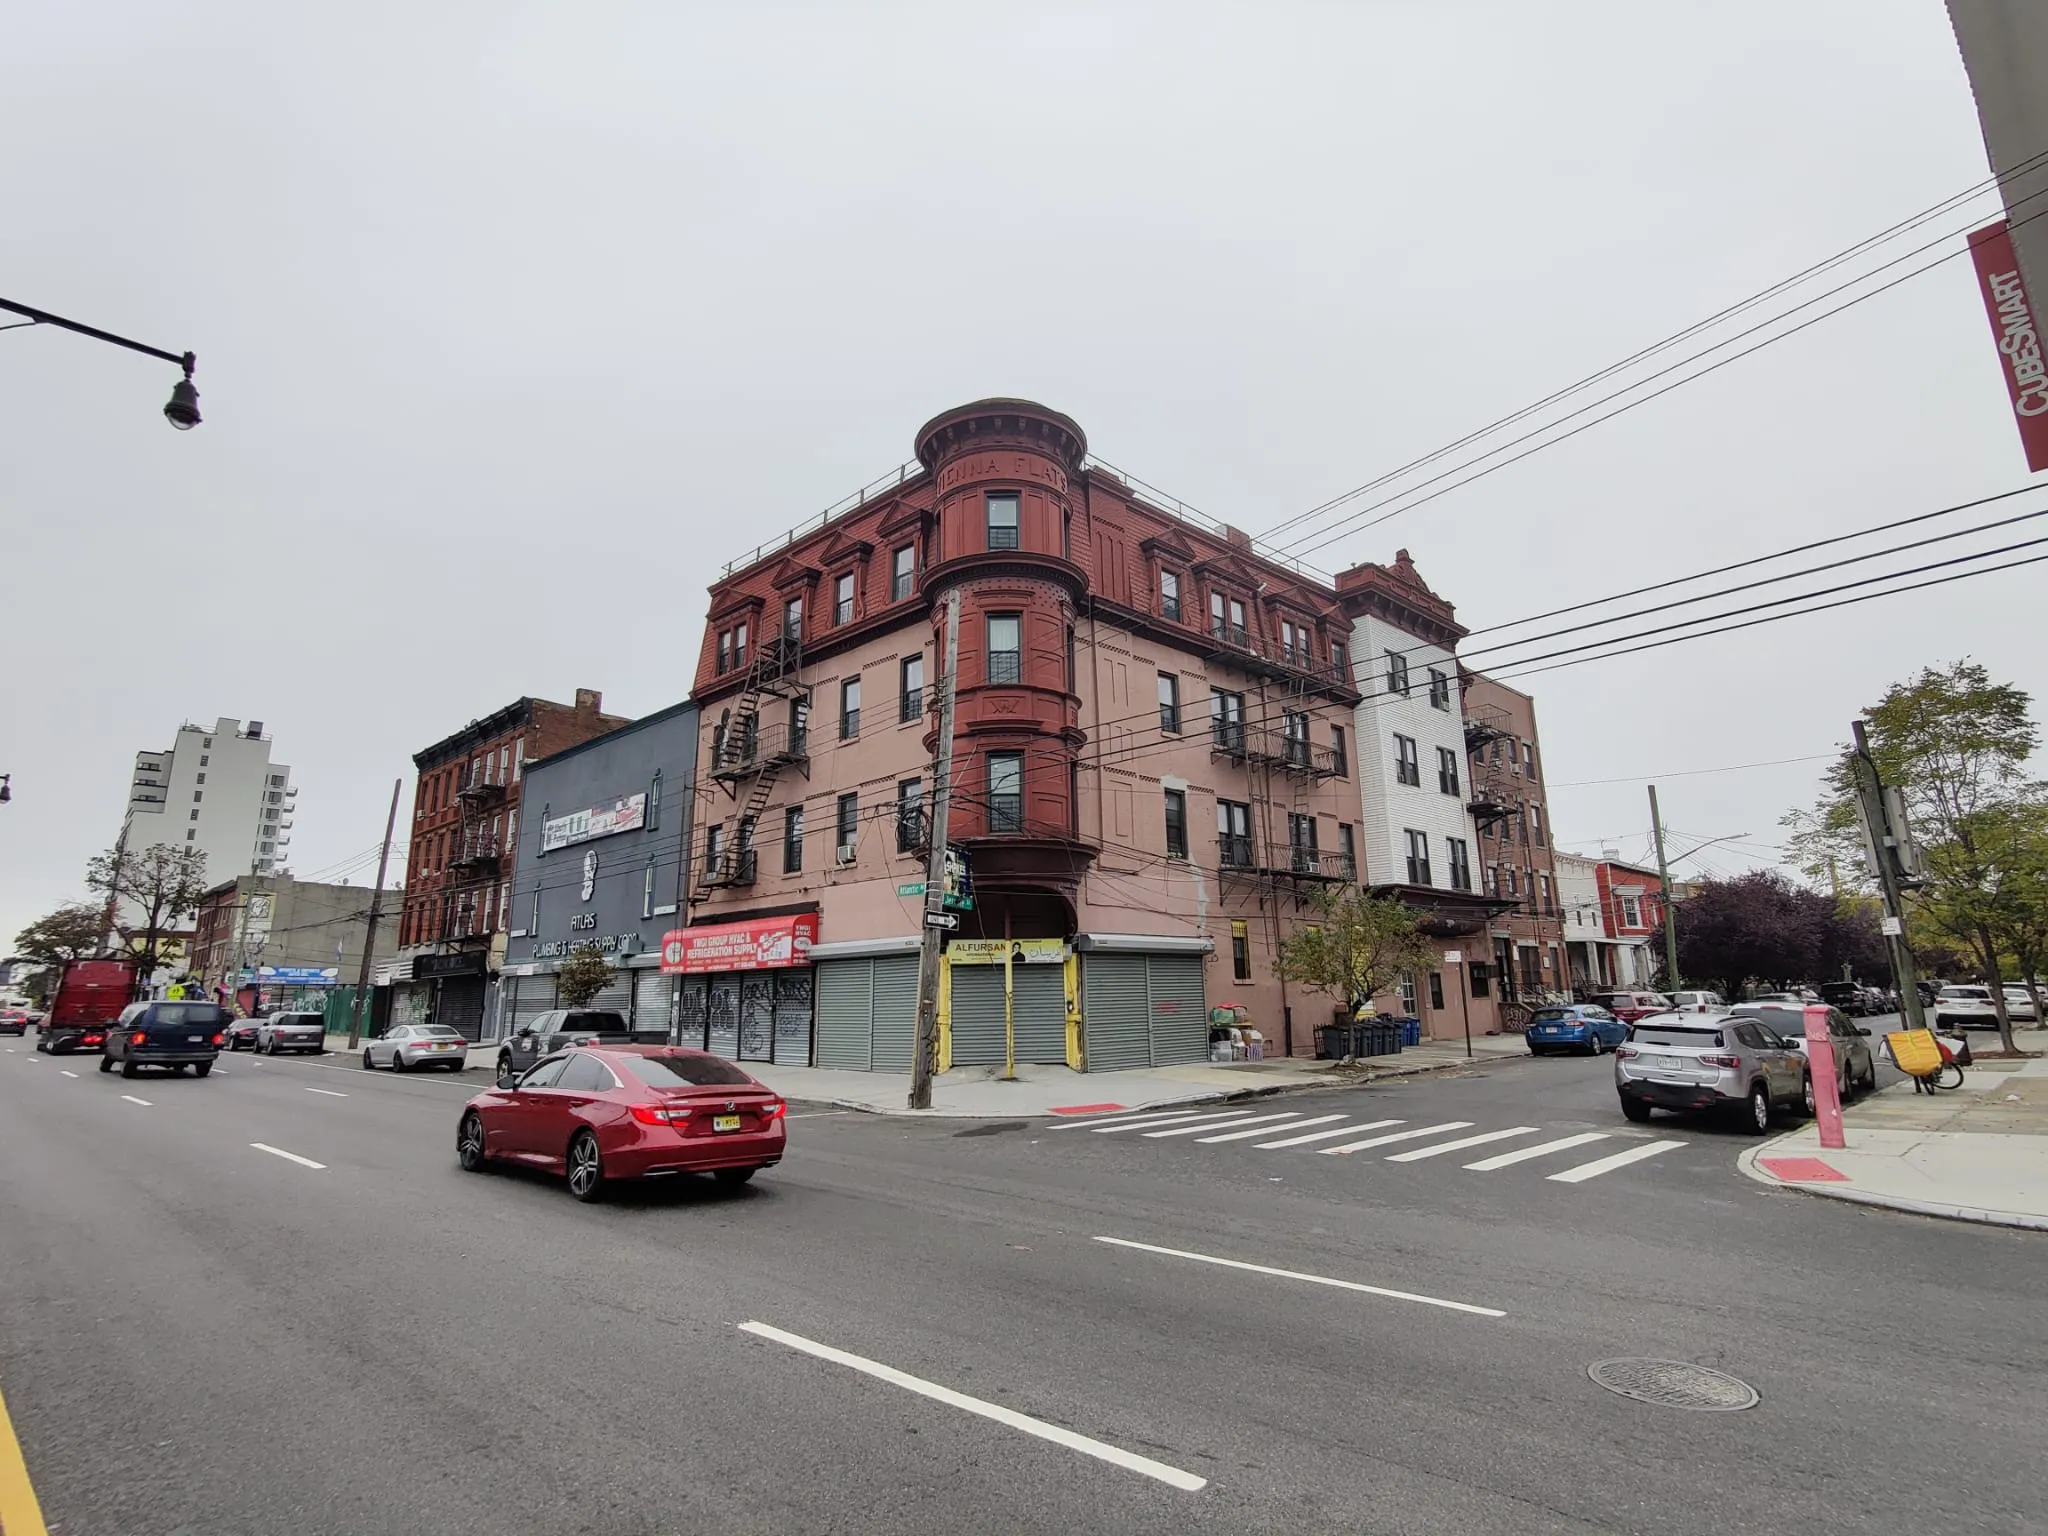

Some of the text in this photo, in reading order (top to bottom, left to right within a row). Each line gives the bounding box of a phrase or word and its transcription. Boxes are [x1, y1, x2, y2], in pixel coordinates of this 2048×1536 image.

[1988, 270, 2048, 417] CUBESMART
[1014, 457, 1067, 493] FLATS
[899, 884, 919, 895] Atlantic
[571, 912, 596, 930] ATLAS
[707, 934, 728, 948] GROUP
[728, 933, 745, 946] HVAC
[955, 943, 1006, 952] ALFURSAN
[532, 942, 562, 959] PLUMBING
[687, 945, 733, 961] REFRIGERATION
[733, 942, 758, 957] SUPPLY
